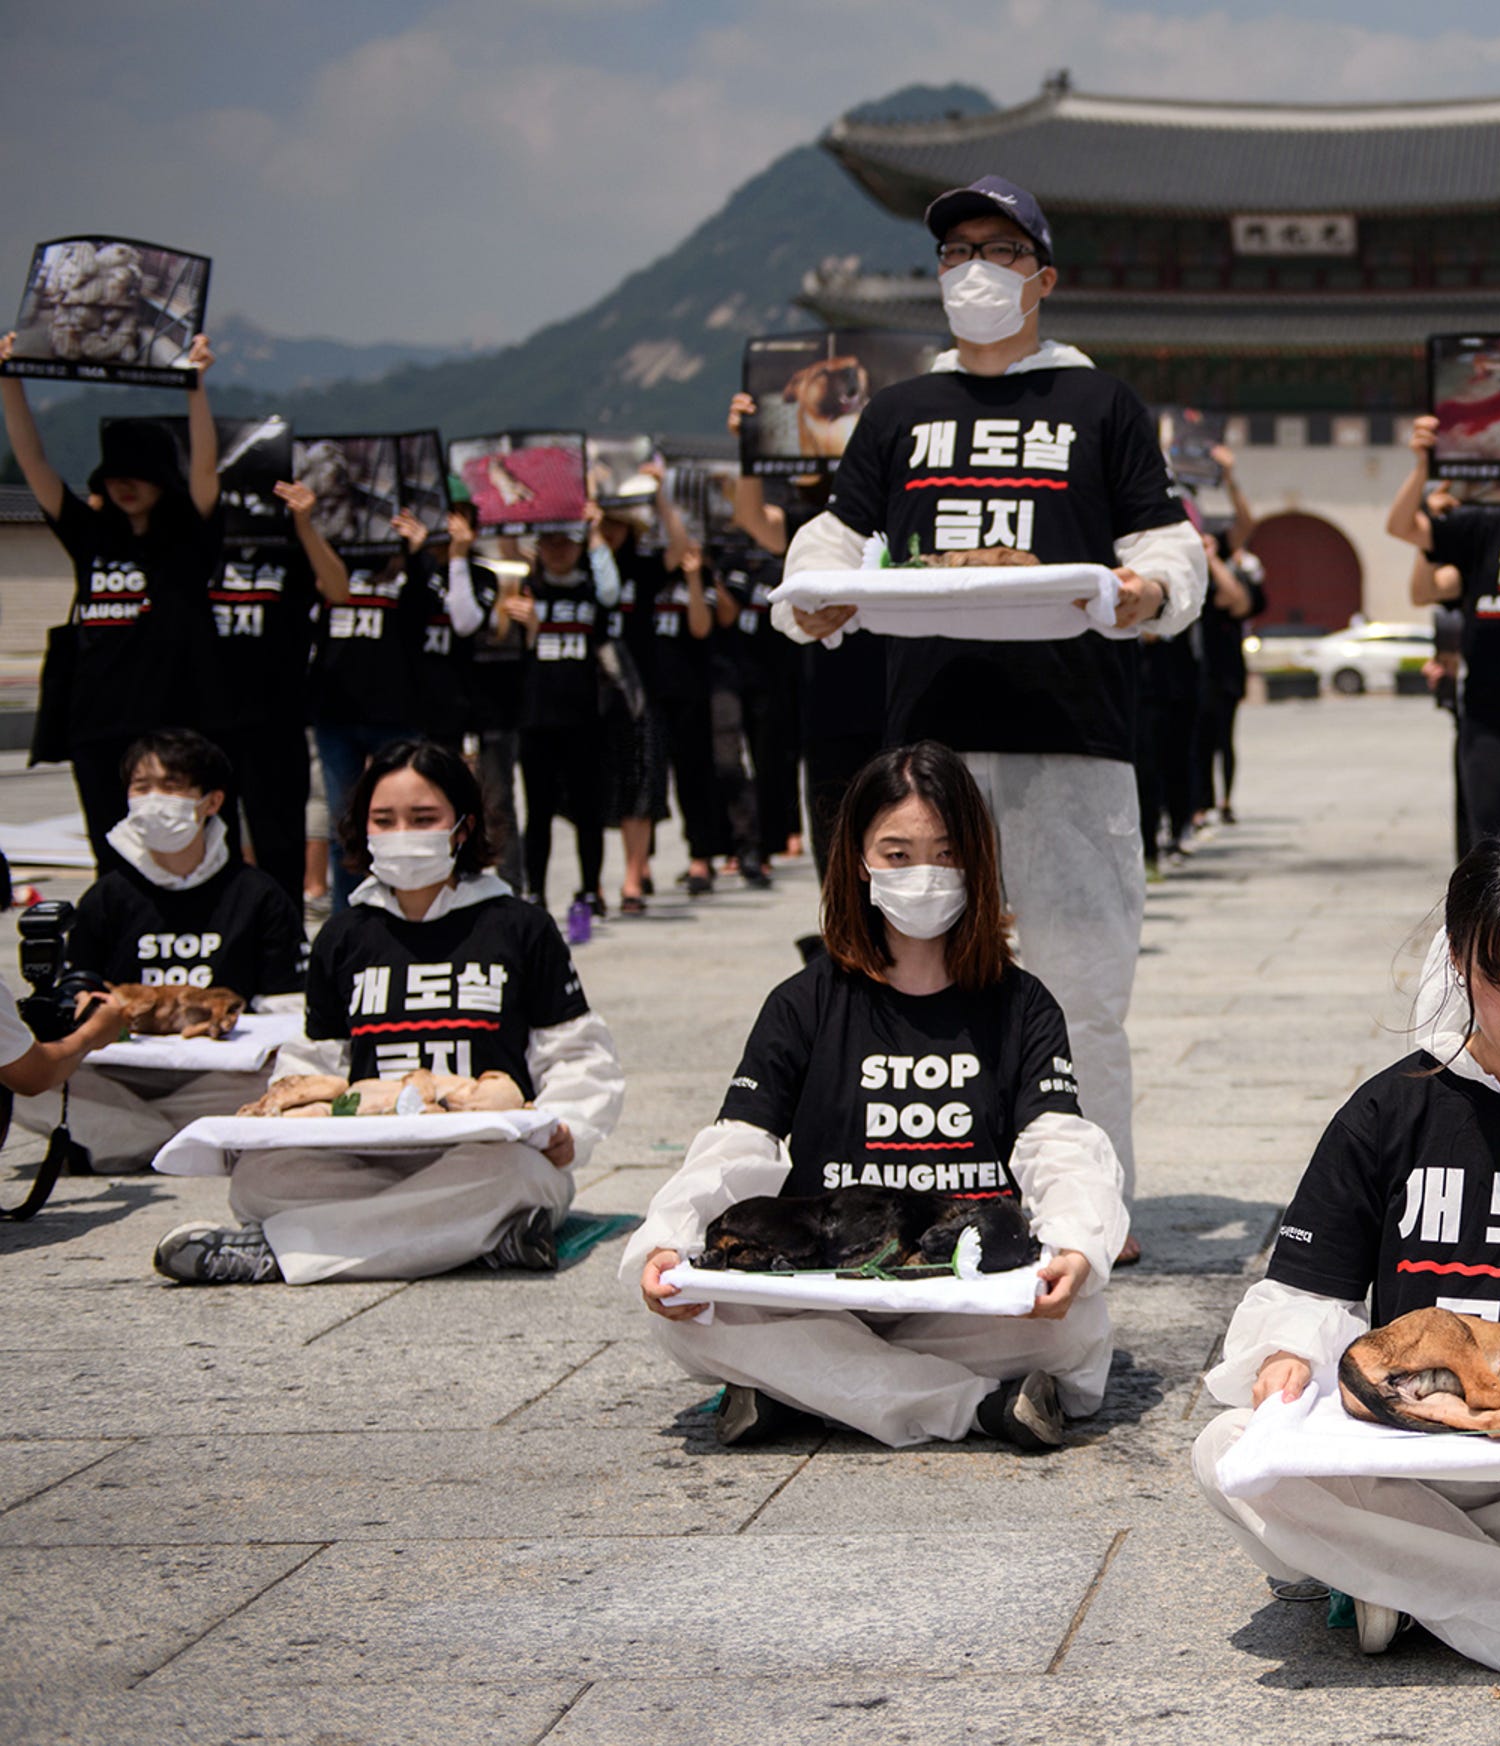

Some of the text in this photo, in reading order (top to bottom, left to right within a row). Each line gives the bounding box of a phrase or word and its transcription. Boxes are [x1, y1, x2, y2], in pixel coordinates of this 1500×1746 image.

[908, 420, 1077, 472] 개 도살
[934, 499, 1035, 552] 금지
[91, 570, 147, 593] DOG
[330, 607, 384, 639] 금지
[537, 632, 587, 660] 금지
[138, 932, 222, 959] STOP
[141, 964, 213, 989] DOG
[349, 962, 508, 1017] 개 도살
[860, 1053, 980, 1090] STOP
[865, 1102, 973, 1138] DOG
[1398, 1166, 1465, 1244] 개
